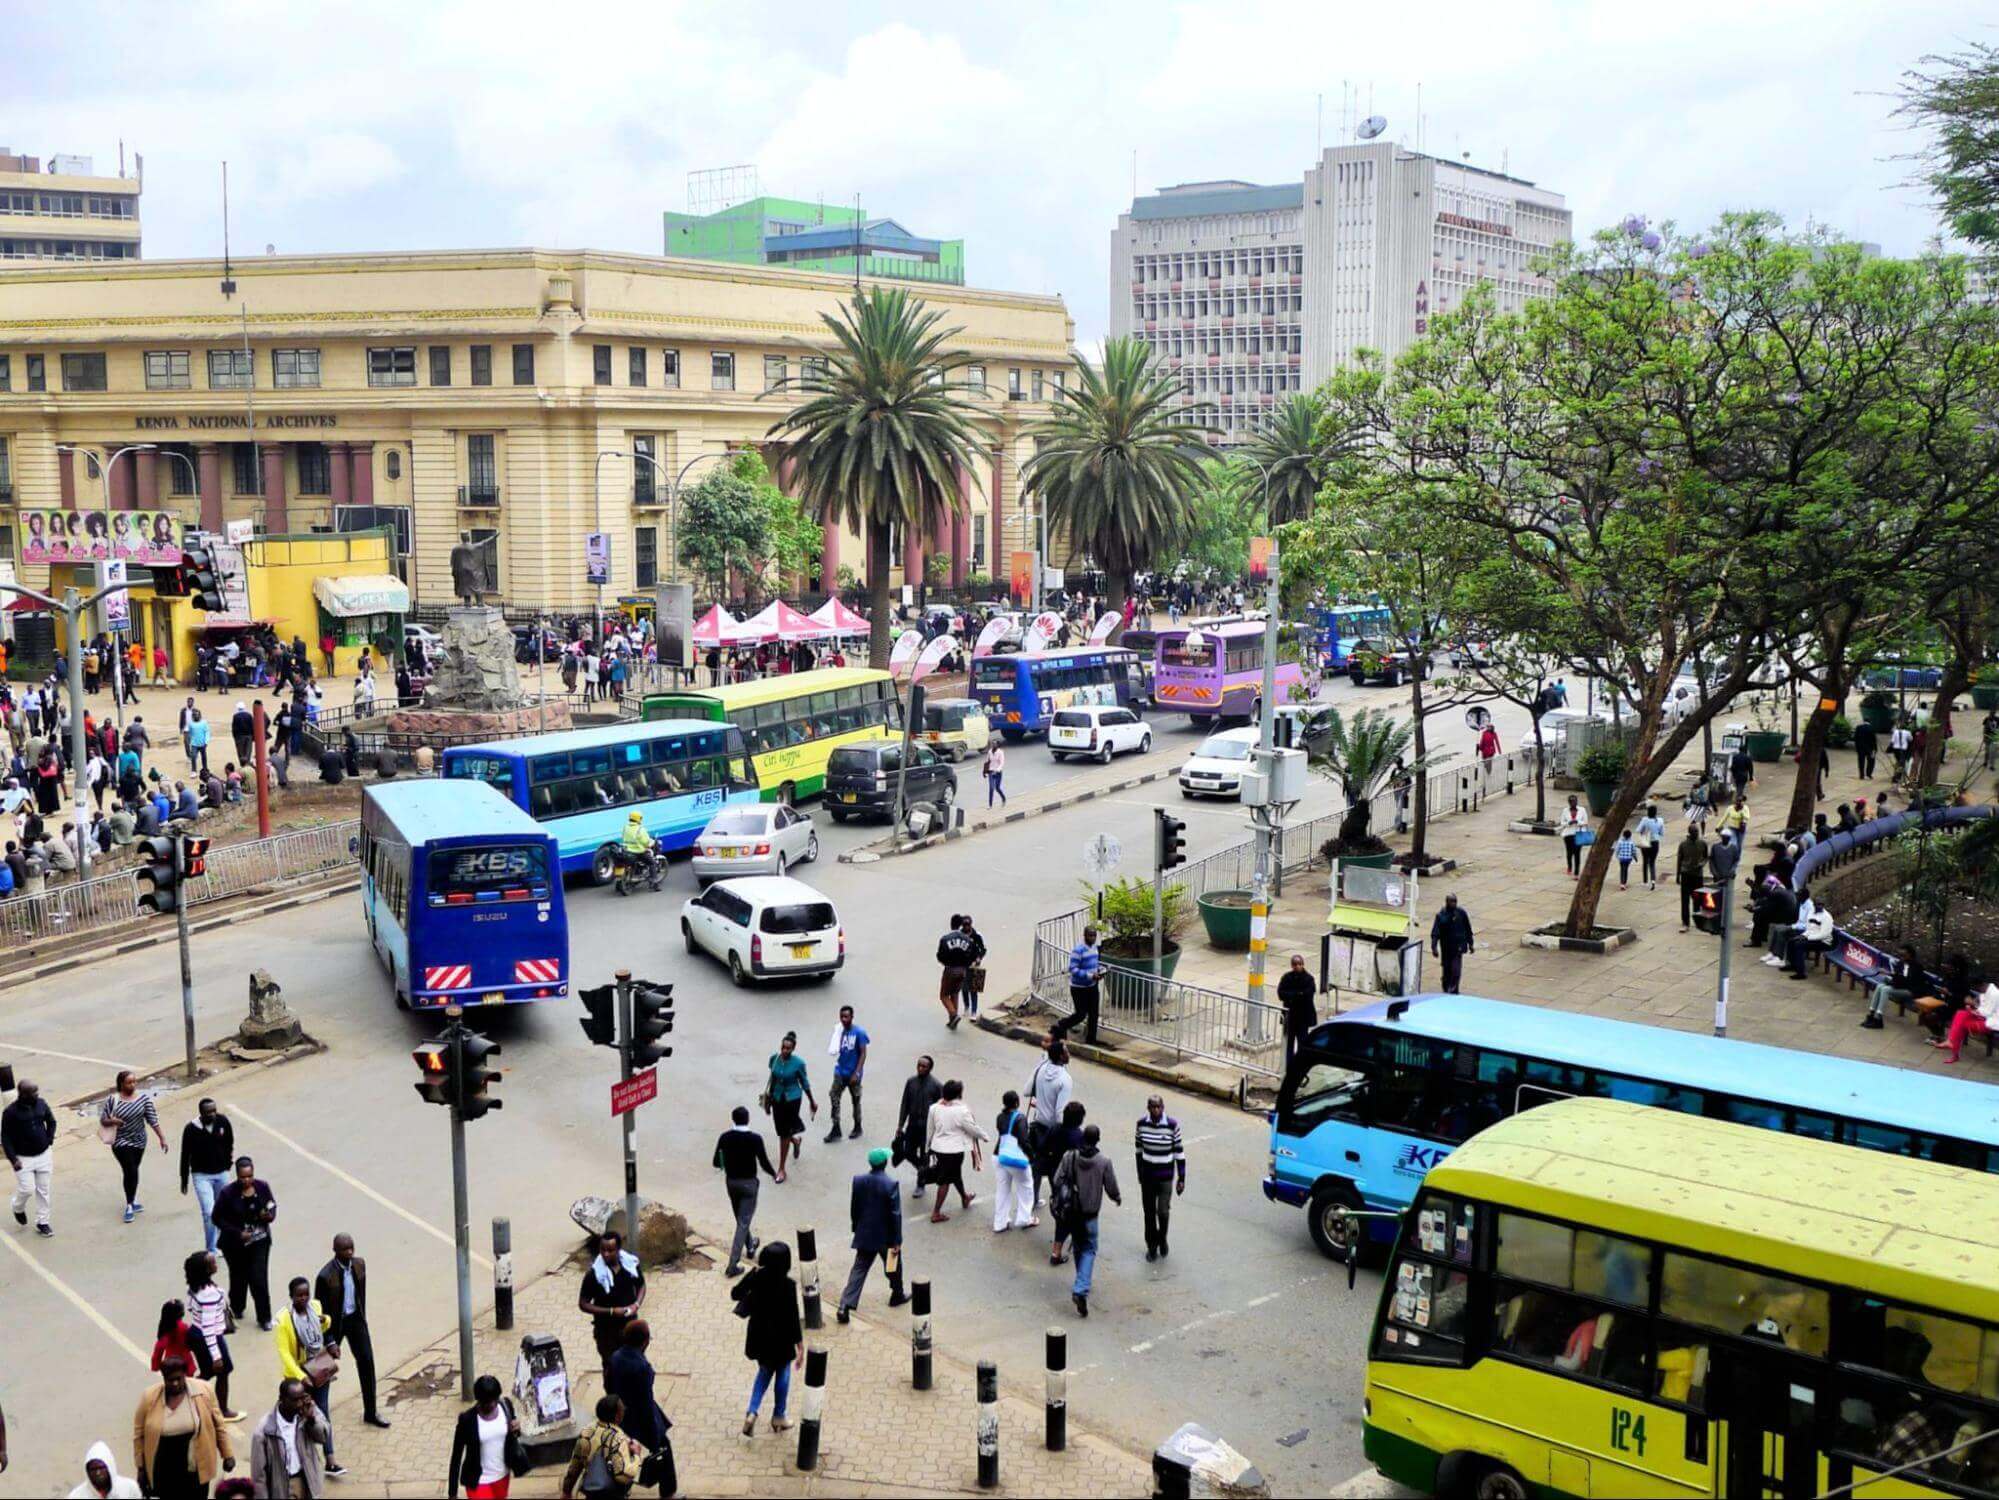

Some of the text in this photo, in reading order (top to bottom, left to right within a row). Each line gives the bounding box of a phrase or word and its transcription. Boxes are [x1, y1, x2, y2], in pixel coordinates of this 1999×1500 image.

[135, 414, 337, 429] KENYA NATIONAL ARCHIVES
[696, 791, 720, 806] KBS
[461, 851, 528, 873] KBS
[472, 912, 508, 922] ISUZU
[1611, 1406, 1648, 1457] 124
